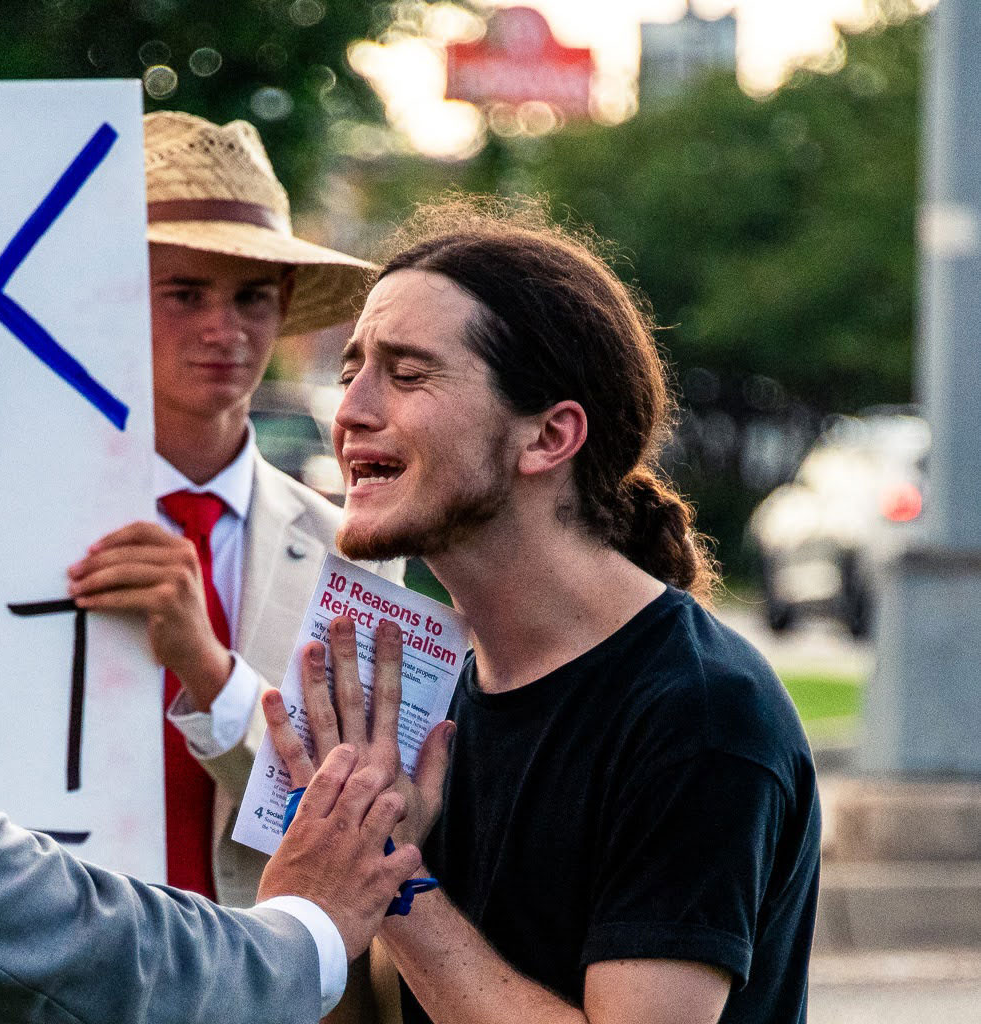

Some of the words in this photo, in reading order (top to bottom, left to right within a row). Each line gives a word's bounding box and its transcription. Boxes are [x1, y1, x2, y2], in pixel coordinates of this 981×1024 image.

[327, 571, 347, 593] 10
[349, 581, 422, 627] Reasons
[425, 615, 443, 637] to
[320, 591, 374, 630] Reject
[376, 618, 457, 667] cialism
[311, 631, 322, 641] and
[358, 651, 368, 660] the
[401, 671, 422, 685] cialism.
[314, 620, 326, 633] Why
[415, 667, 439, 683] property
[288, 704, 297, 719] 2
[410, 703, 430, 718] ideology
[265, 765, 276, 779] 3
[254, 806, 264, 819] 4
[266, 809, 284, 821] Sociali
